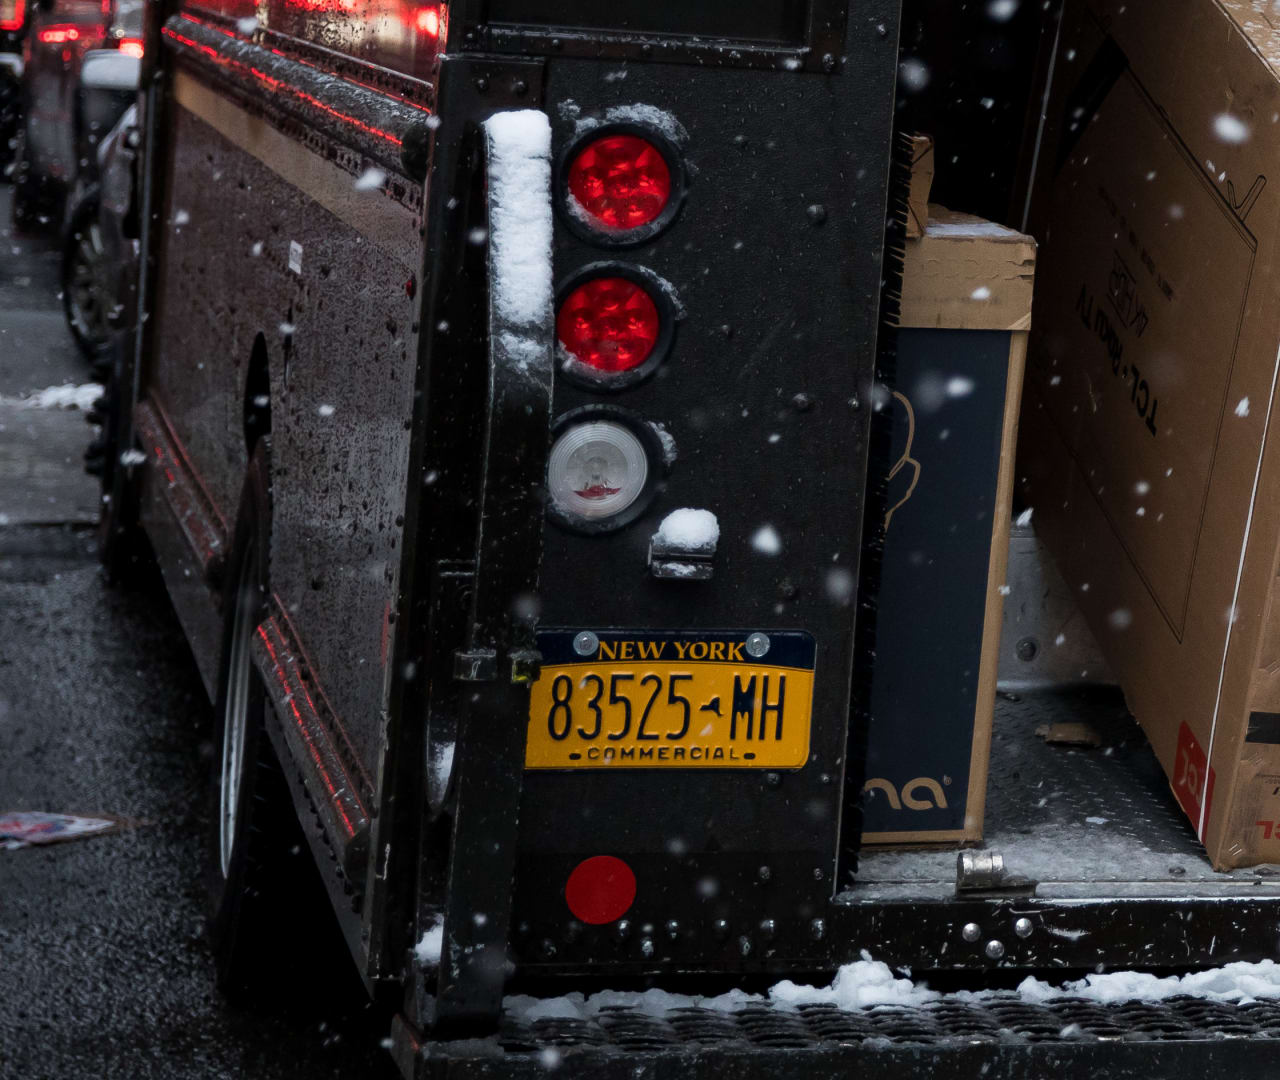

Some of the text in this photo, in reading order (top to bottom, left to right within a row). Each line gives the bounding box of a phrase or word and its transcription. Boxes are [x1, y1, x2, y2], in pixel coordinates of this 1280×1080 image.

[597, 640, 746, 662] NEW YORK
[547, 673, 787, 741] 83525 MH
[586, 746, 741, 761] COMMERCIAL
